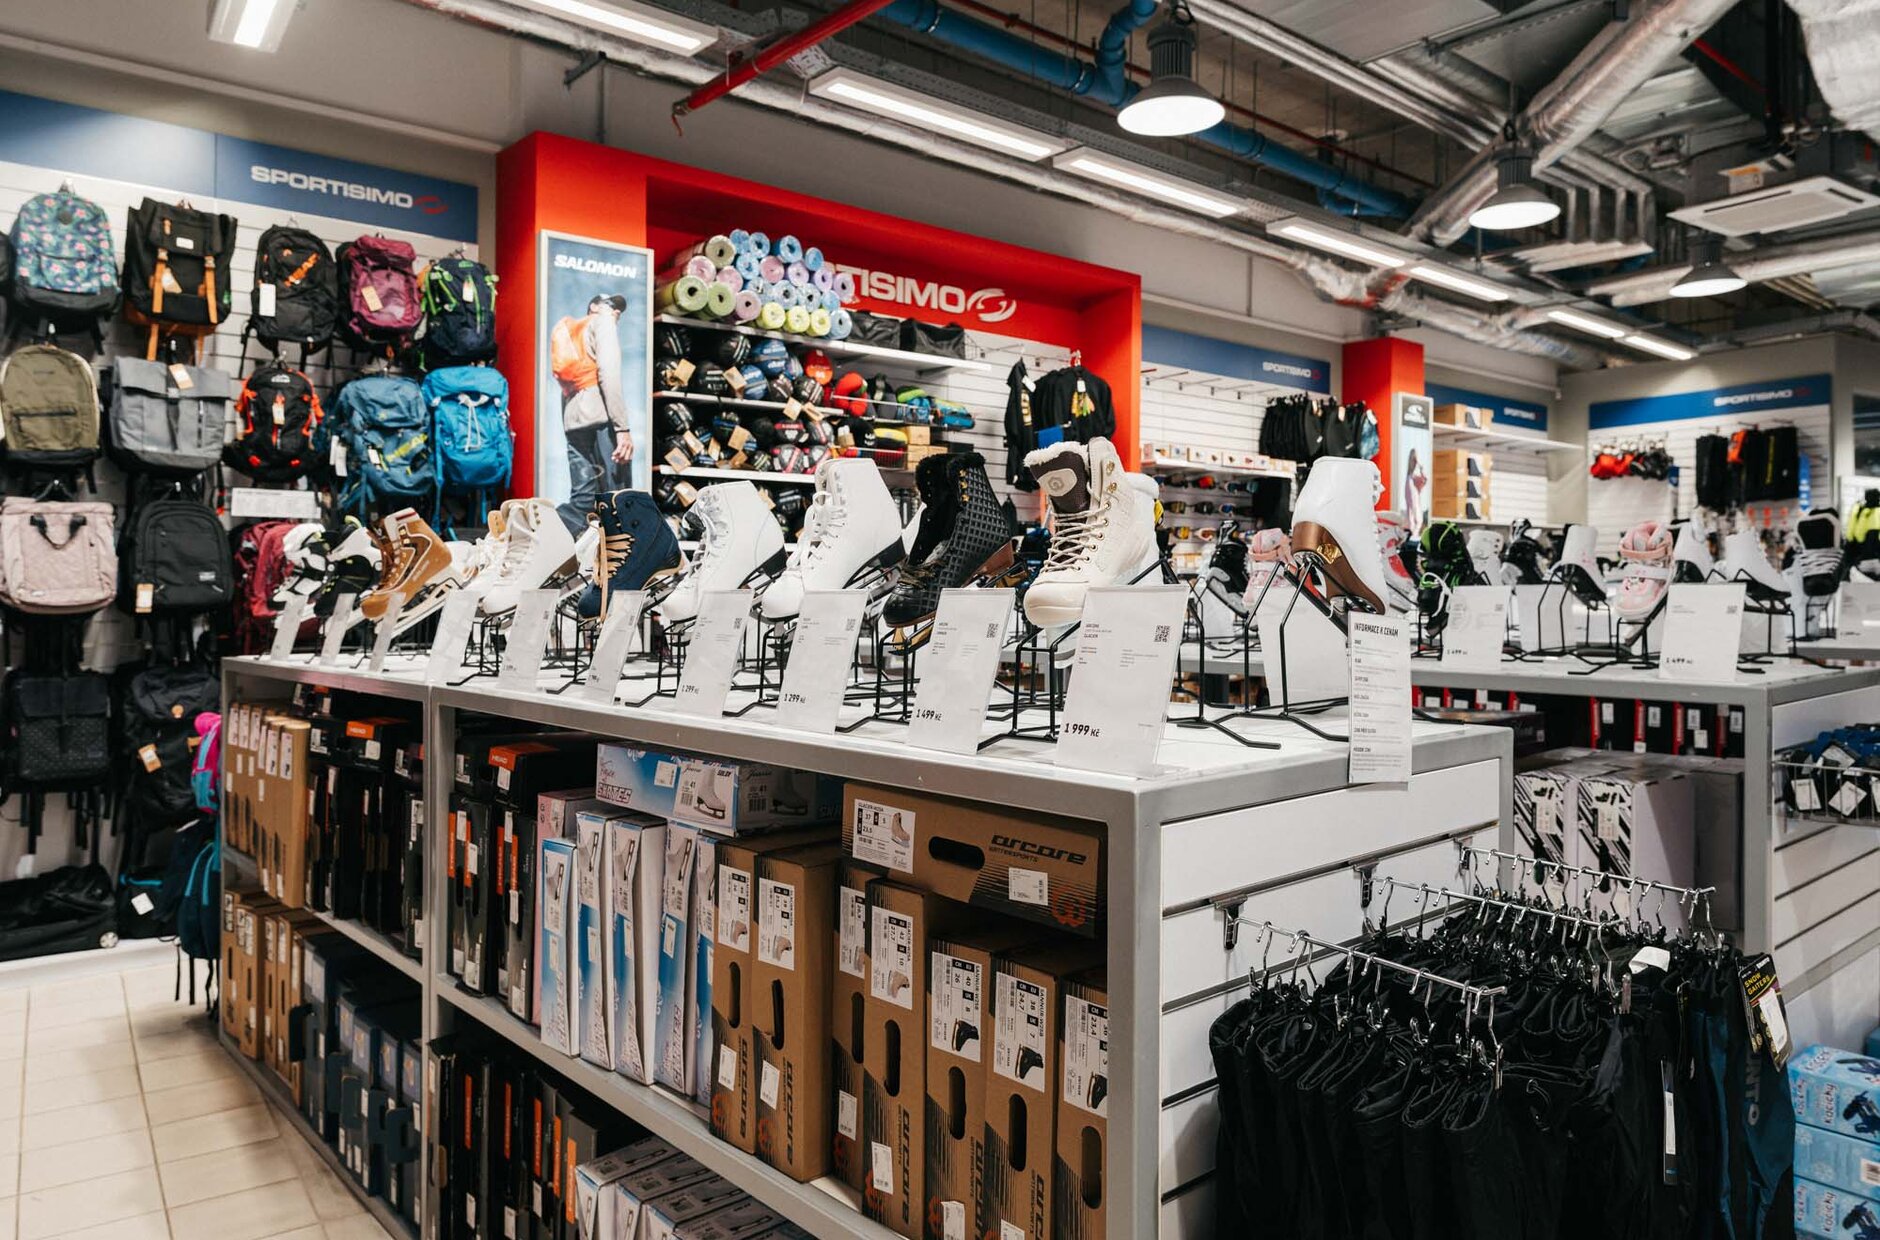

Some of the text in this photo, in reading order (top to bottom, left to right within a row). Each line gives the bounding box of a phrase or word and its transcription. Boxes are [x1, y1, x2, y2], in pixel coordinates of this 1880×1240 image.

[251, 165, 413, 209] SPORTISIMO
[554, 255, 636, 278] SALOMON
[1354, 622, 1379, 635] INFORMACE
[788, 694, 800, 703] 299
[921, 709, 935, 719] 499
[1072, 723, 1090, 735] 999
[1090, 728, 1100, 737] Kč
[597, 783, 632, 804] SKATES
[991, 834, 1087, 866] arcore
[899, 957, 904, 966] 10
[955, 973, 960, 984] 26
[966, 976, 971, 987] 40
[1744, 972, 1761, 988] SNOW
[1747, 975, 1770, 995] GAITERS
[1030, 1000, 1036, 1011] 38
[740, 1038, 748, 1139] arcore
[902, 1108, 910, 1226] arcore
[1036, 1174, 1045, 1240] arc
